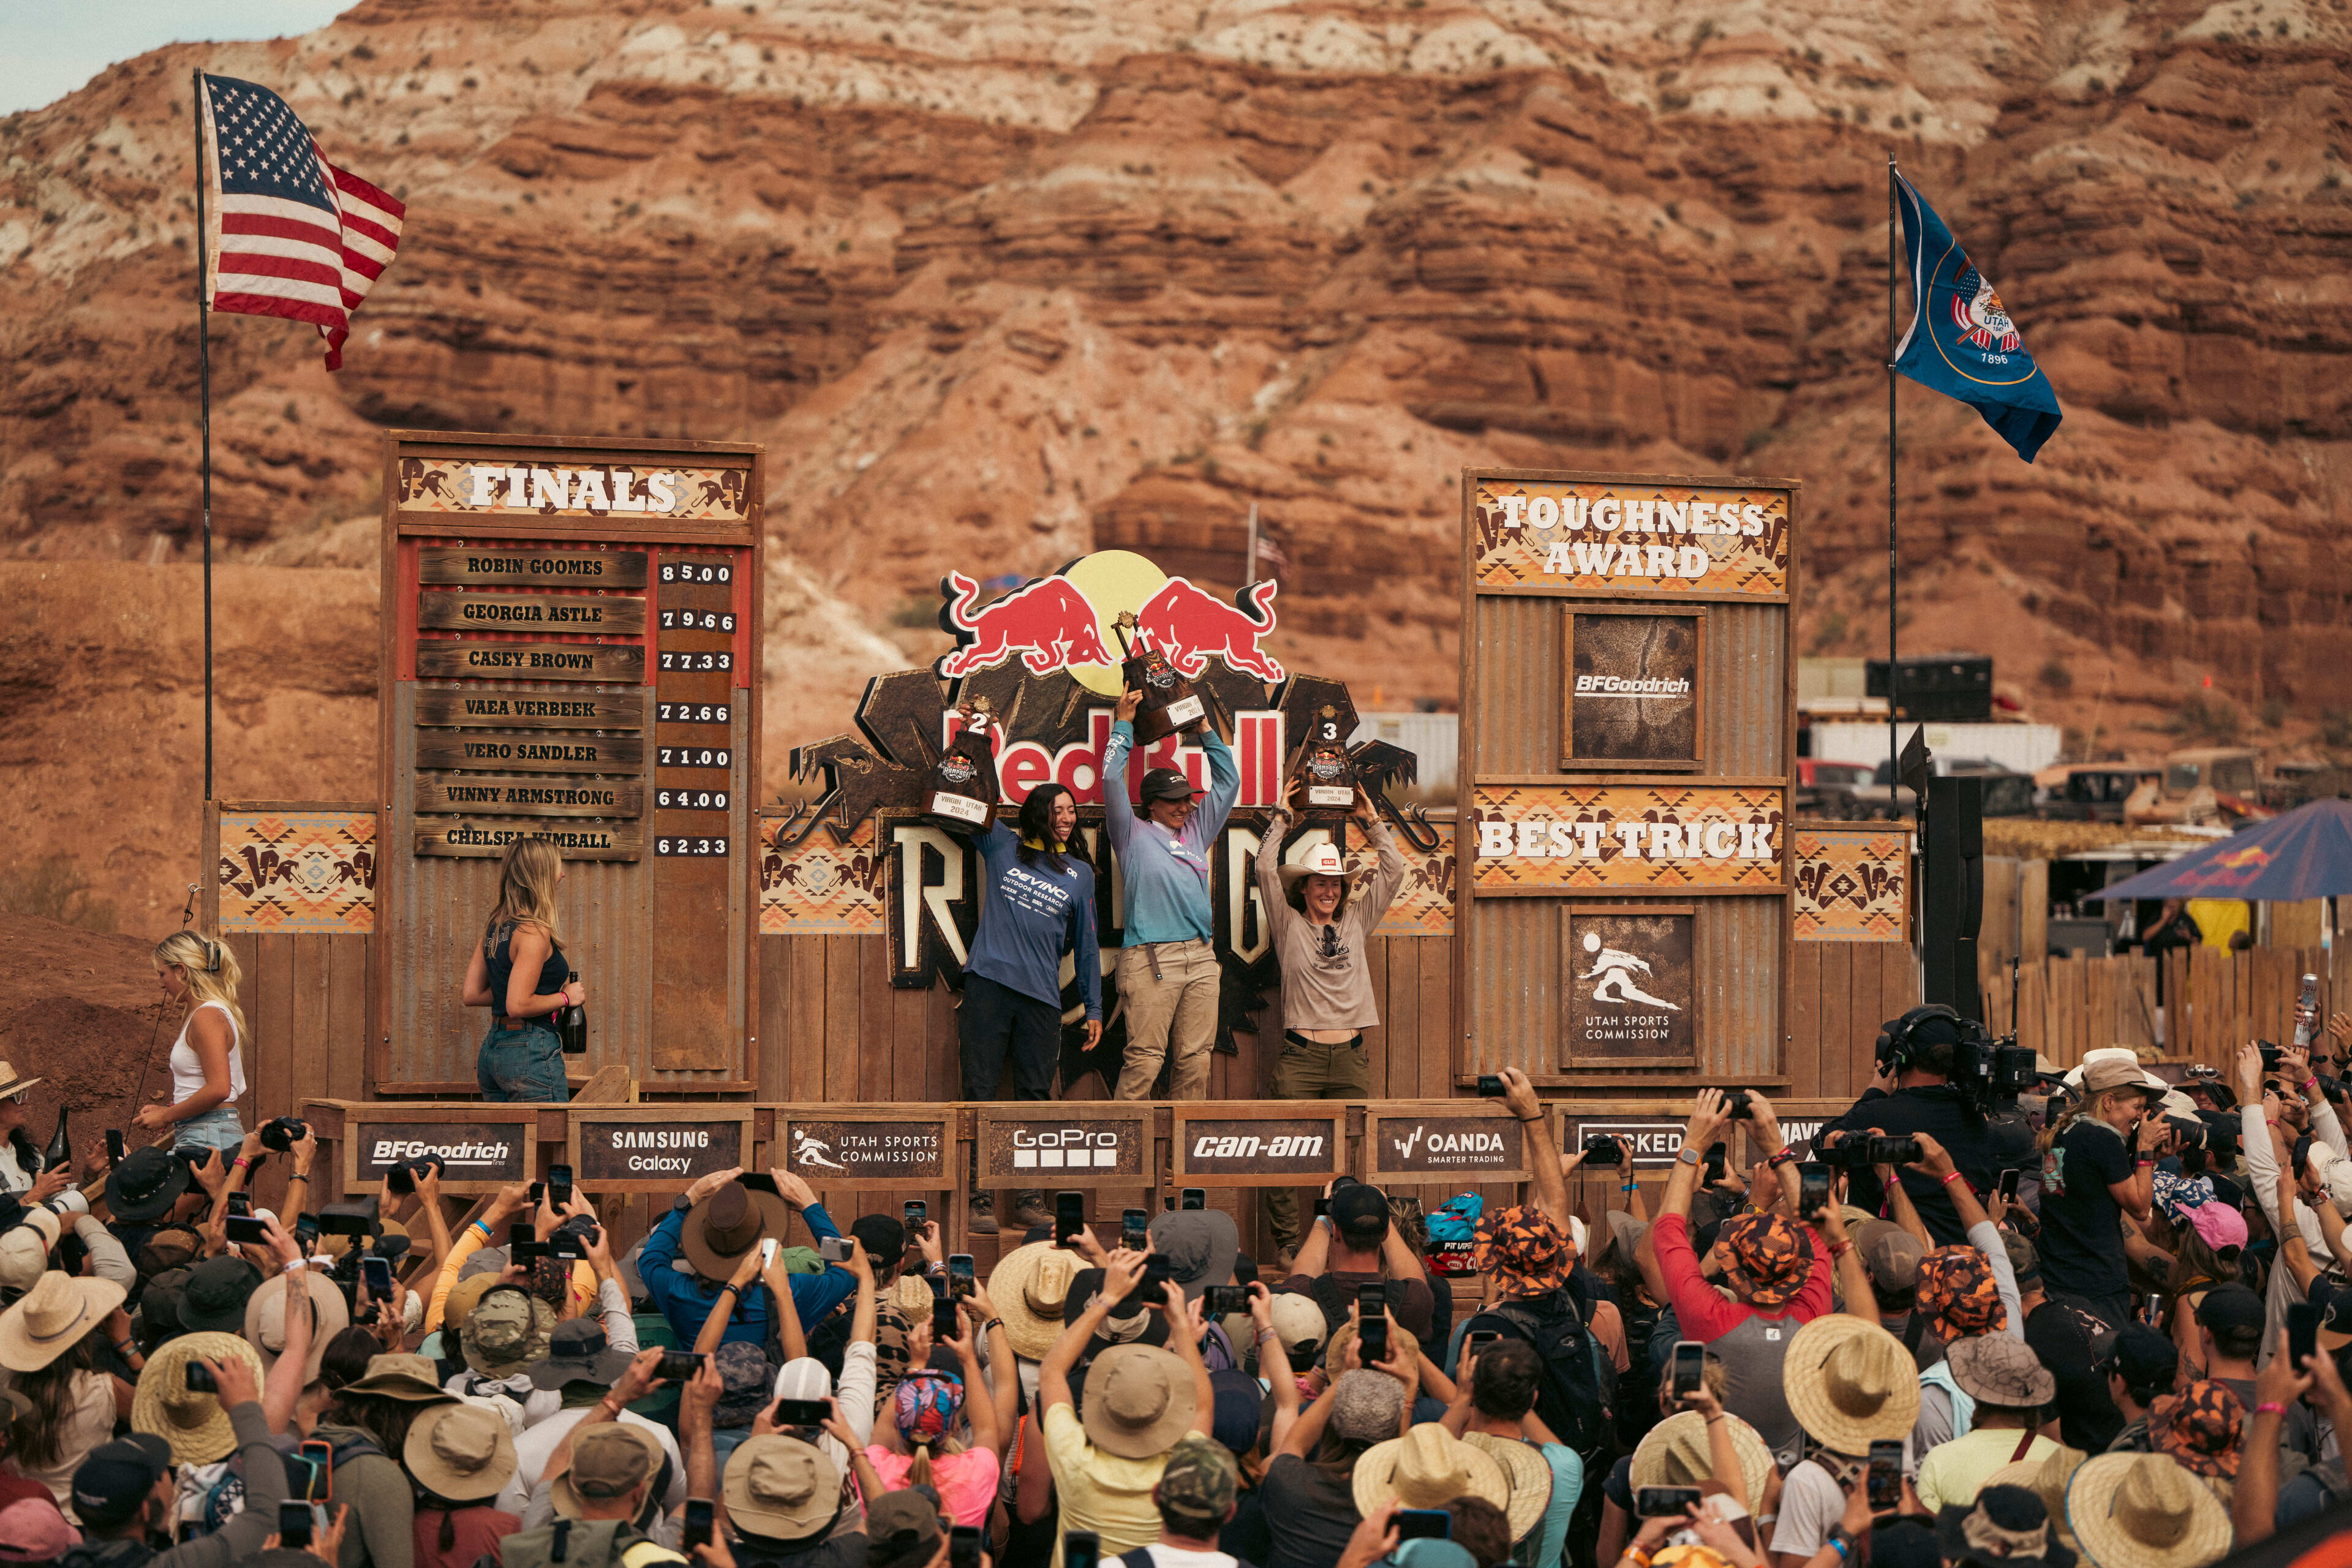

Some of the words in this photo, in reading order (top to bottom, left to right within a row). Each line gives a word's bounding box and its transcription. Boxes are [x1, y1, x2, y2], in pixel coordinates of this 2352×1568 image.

[1985, 315, 2008, 328] UTAH
[1981, 352, 2008, 364] 1896
[470, 467, 676, 513] FINALS
[1498, 496, 1765, 536] TOUGHNESS
[468, 557, 523, 574] ROBIN
[530, 559, 603, 575] GOOMES
[1544, 542, 1709, 578] AWARD
[663, 565, 729, 581] 85.00
[464, 604, 542, 621] GEORGIA
[548, 606, 602, 622] ASTLE
[663, 612, 733, 630] 79.66
[469, 651, 524, 668] CASEY
[530, 653, 594, 669] BROWN
[663, 654, 729, 669] 77.33
[1576, 676, 1690, 692] BFGoodrich
[466, 699, 510, 715] VAEA
[514, 701, 596, 717] VERBEEK
[662, 705, 727, 721] 72.66
[968, 713, 987, 734] 2
[1323, 723, 1336, 739] 3
[464, 743, 511, 758] VERO
[518, 745, 597, 761] SANDLER
[662, 749, 728, 766] 71.00
[447, 786, 501, 802] VINNY
[505, 788, 614, 805] ARMSTRONG
[659, 792, 726, 807] 64.00
[941, 796, 961, 805] VIRGIN
[967, 801, 982, 811] UTAH
[950, 805, 969, 816] 2024
[659, 840, 725, 854] 62.33
[1257, 827, 1273, 855] ROYALE
[1479, 821, 1606, 858] BEST
[1616, 822, 1773, 858] TRICK
[1067, 867, 1077, 880] OR
[1003, 876, 1032, 892] OUTDOOR
[1033, 890, 1063, 908] RESEARCH
[1006, 867, 1069, 901] DEVINCI
[1586, 1017, 1618, 1026] UTAH
[1624, 1016, 1669, 1026] SPORTS
[1586, 1028, 1668, 1039] COMMISSION
[612, 1131, 709, 1148] SAMSUNG
[840, 1136, 878, 1147] UTAH
[885, 1136, 937, 1147] SPORTS
[1014, 1129, 1117, 1147] GoPro
[1194, 1136, 1323, 1157] can-am
[1427, 1134, 1504, 1152] OANDA
[628, 1155, 691, 1174] Galaxy
[840, 1152, 936, 1162] COMMISSION
